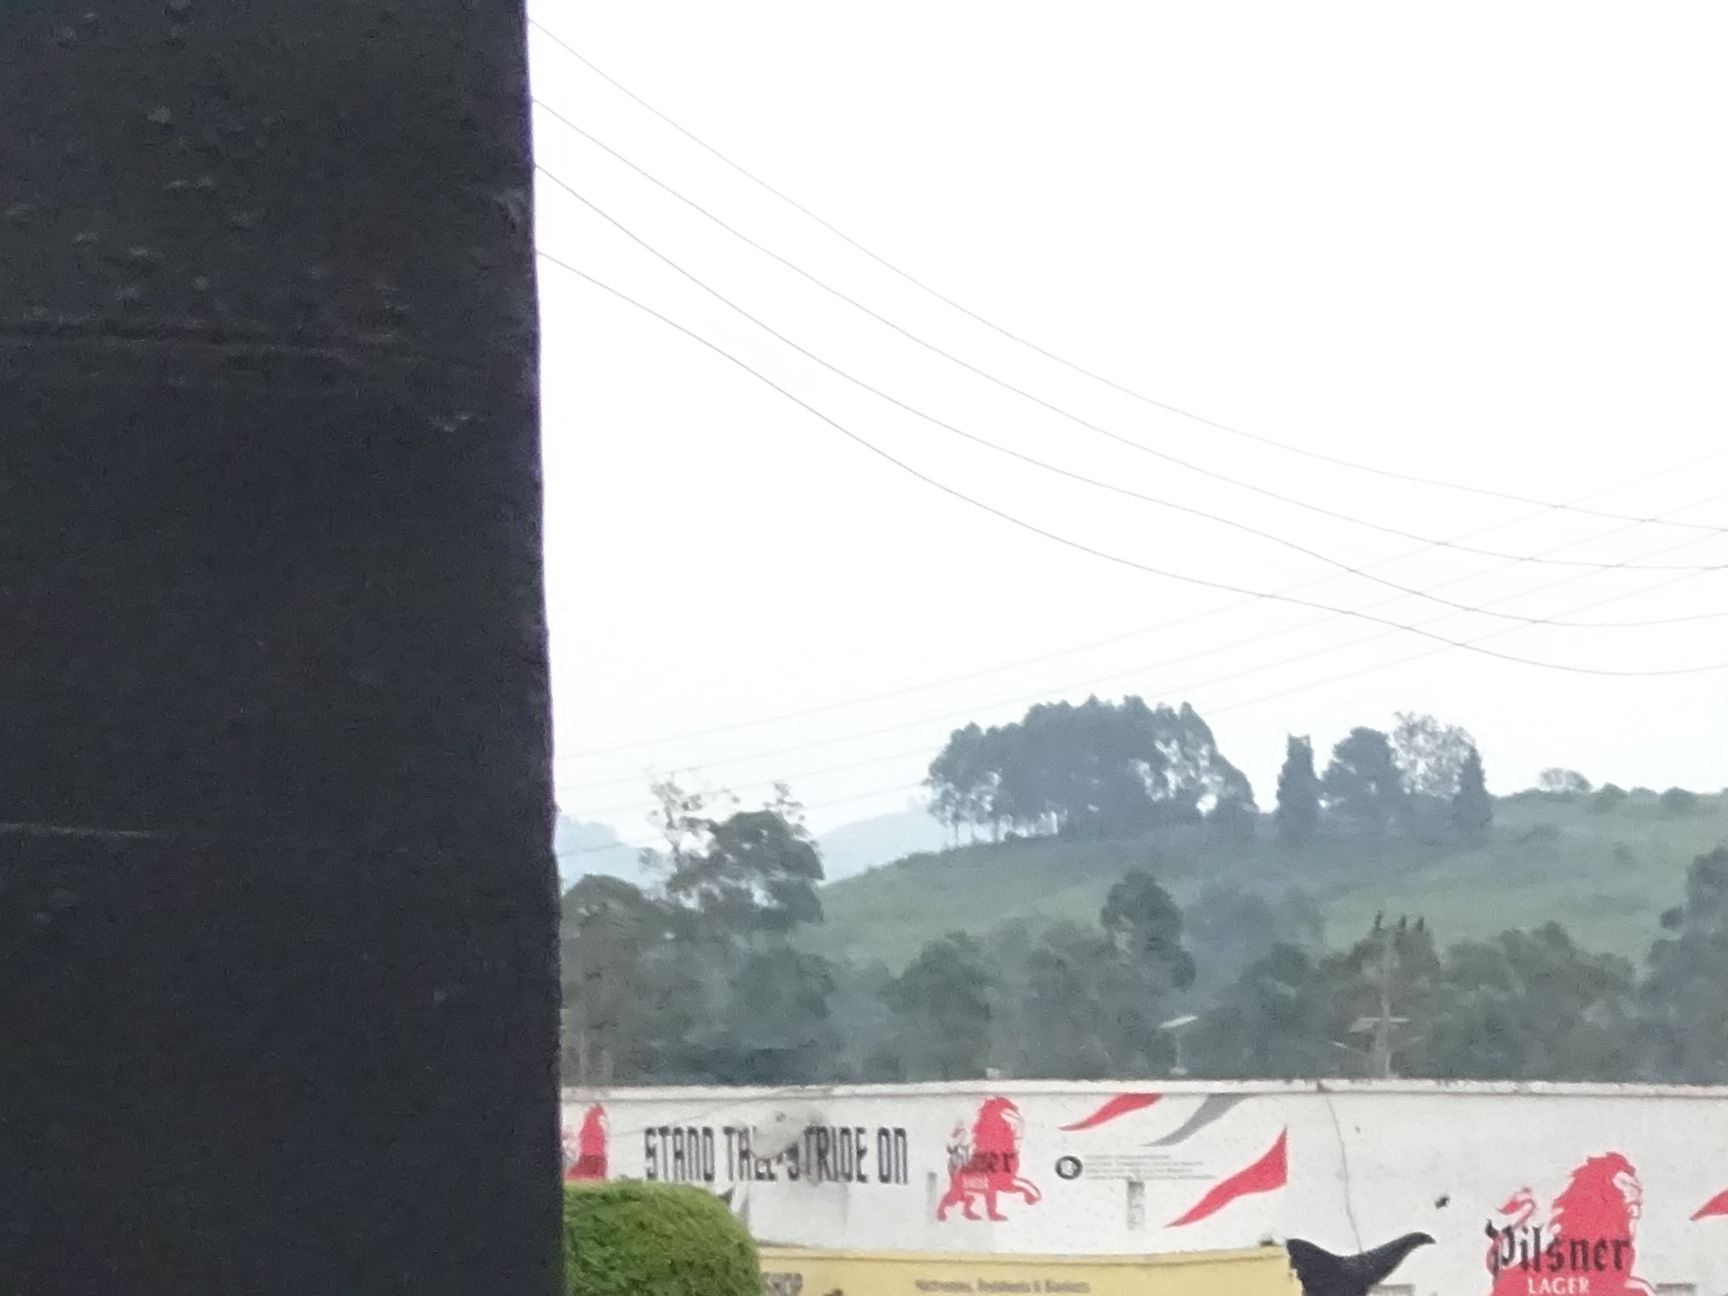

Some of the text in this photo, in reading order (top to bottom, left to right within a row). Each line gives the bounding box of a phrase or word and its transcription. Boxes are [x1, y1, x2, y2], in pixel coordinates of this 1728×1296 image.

[644, 1125, 715, 1183] STAND
[876, 1126, 909, 1185] ON
[1485, 1219, 1633, 1278] Pilsner
[1527, 1276, 1591, 1294] LAGER
